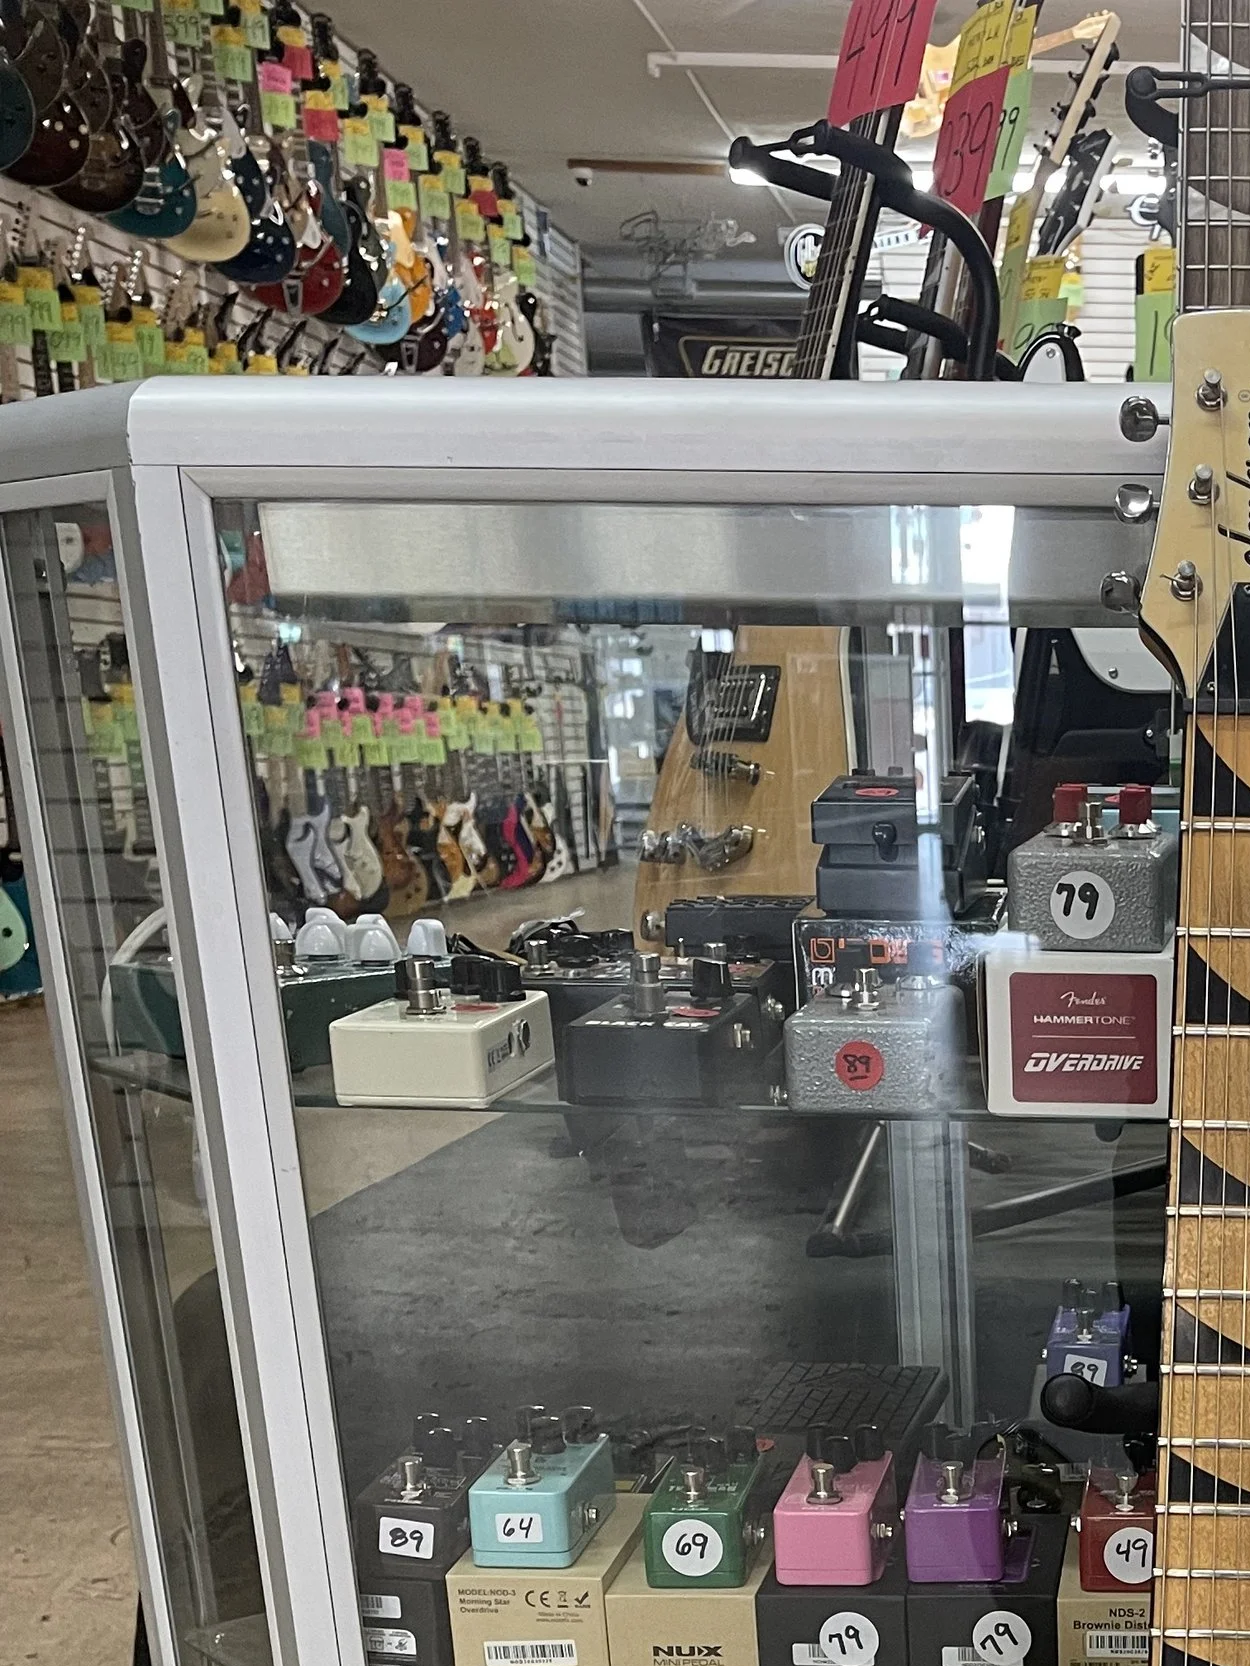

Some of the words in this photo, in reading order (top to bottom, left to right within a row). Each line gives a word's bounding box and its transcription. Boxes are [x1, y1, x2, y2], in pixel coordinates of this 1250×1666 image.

[702, 345, 798, 377] GRETSC
[1055, 882, 1100, 921] 79
[1060, 991, 1106, 1008] Fender
[1033, 1014, 1132, 1026] HAMMERTONE
[843, 1054, 873, 1075] 89
[1024, 1052, 1145, 1073] OVERDRIVE
[502, 1516, 533, 1539] 64
[388, 1527, 424, 1553] 89
[675, 1532, 709, 1559] 69
[1115, 1538, 1148, 1568] 49
[459, 1598, 493, 1606] Morning
[494, 1597, 511, 1605] Star
[1108, 1608, 1146, 1618] NDS-2
[1073, 1620, 1121, 1630] Brownie
[828, 1624, 864, 1655] 79
[979, 1622, 1019, 1656] 79
[653, 1658, 681, 1666] MINI
[682, 1658, 725, 1666] PEDAL
